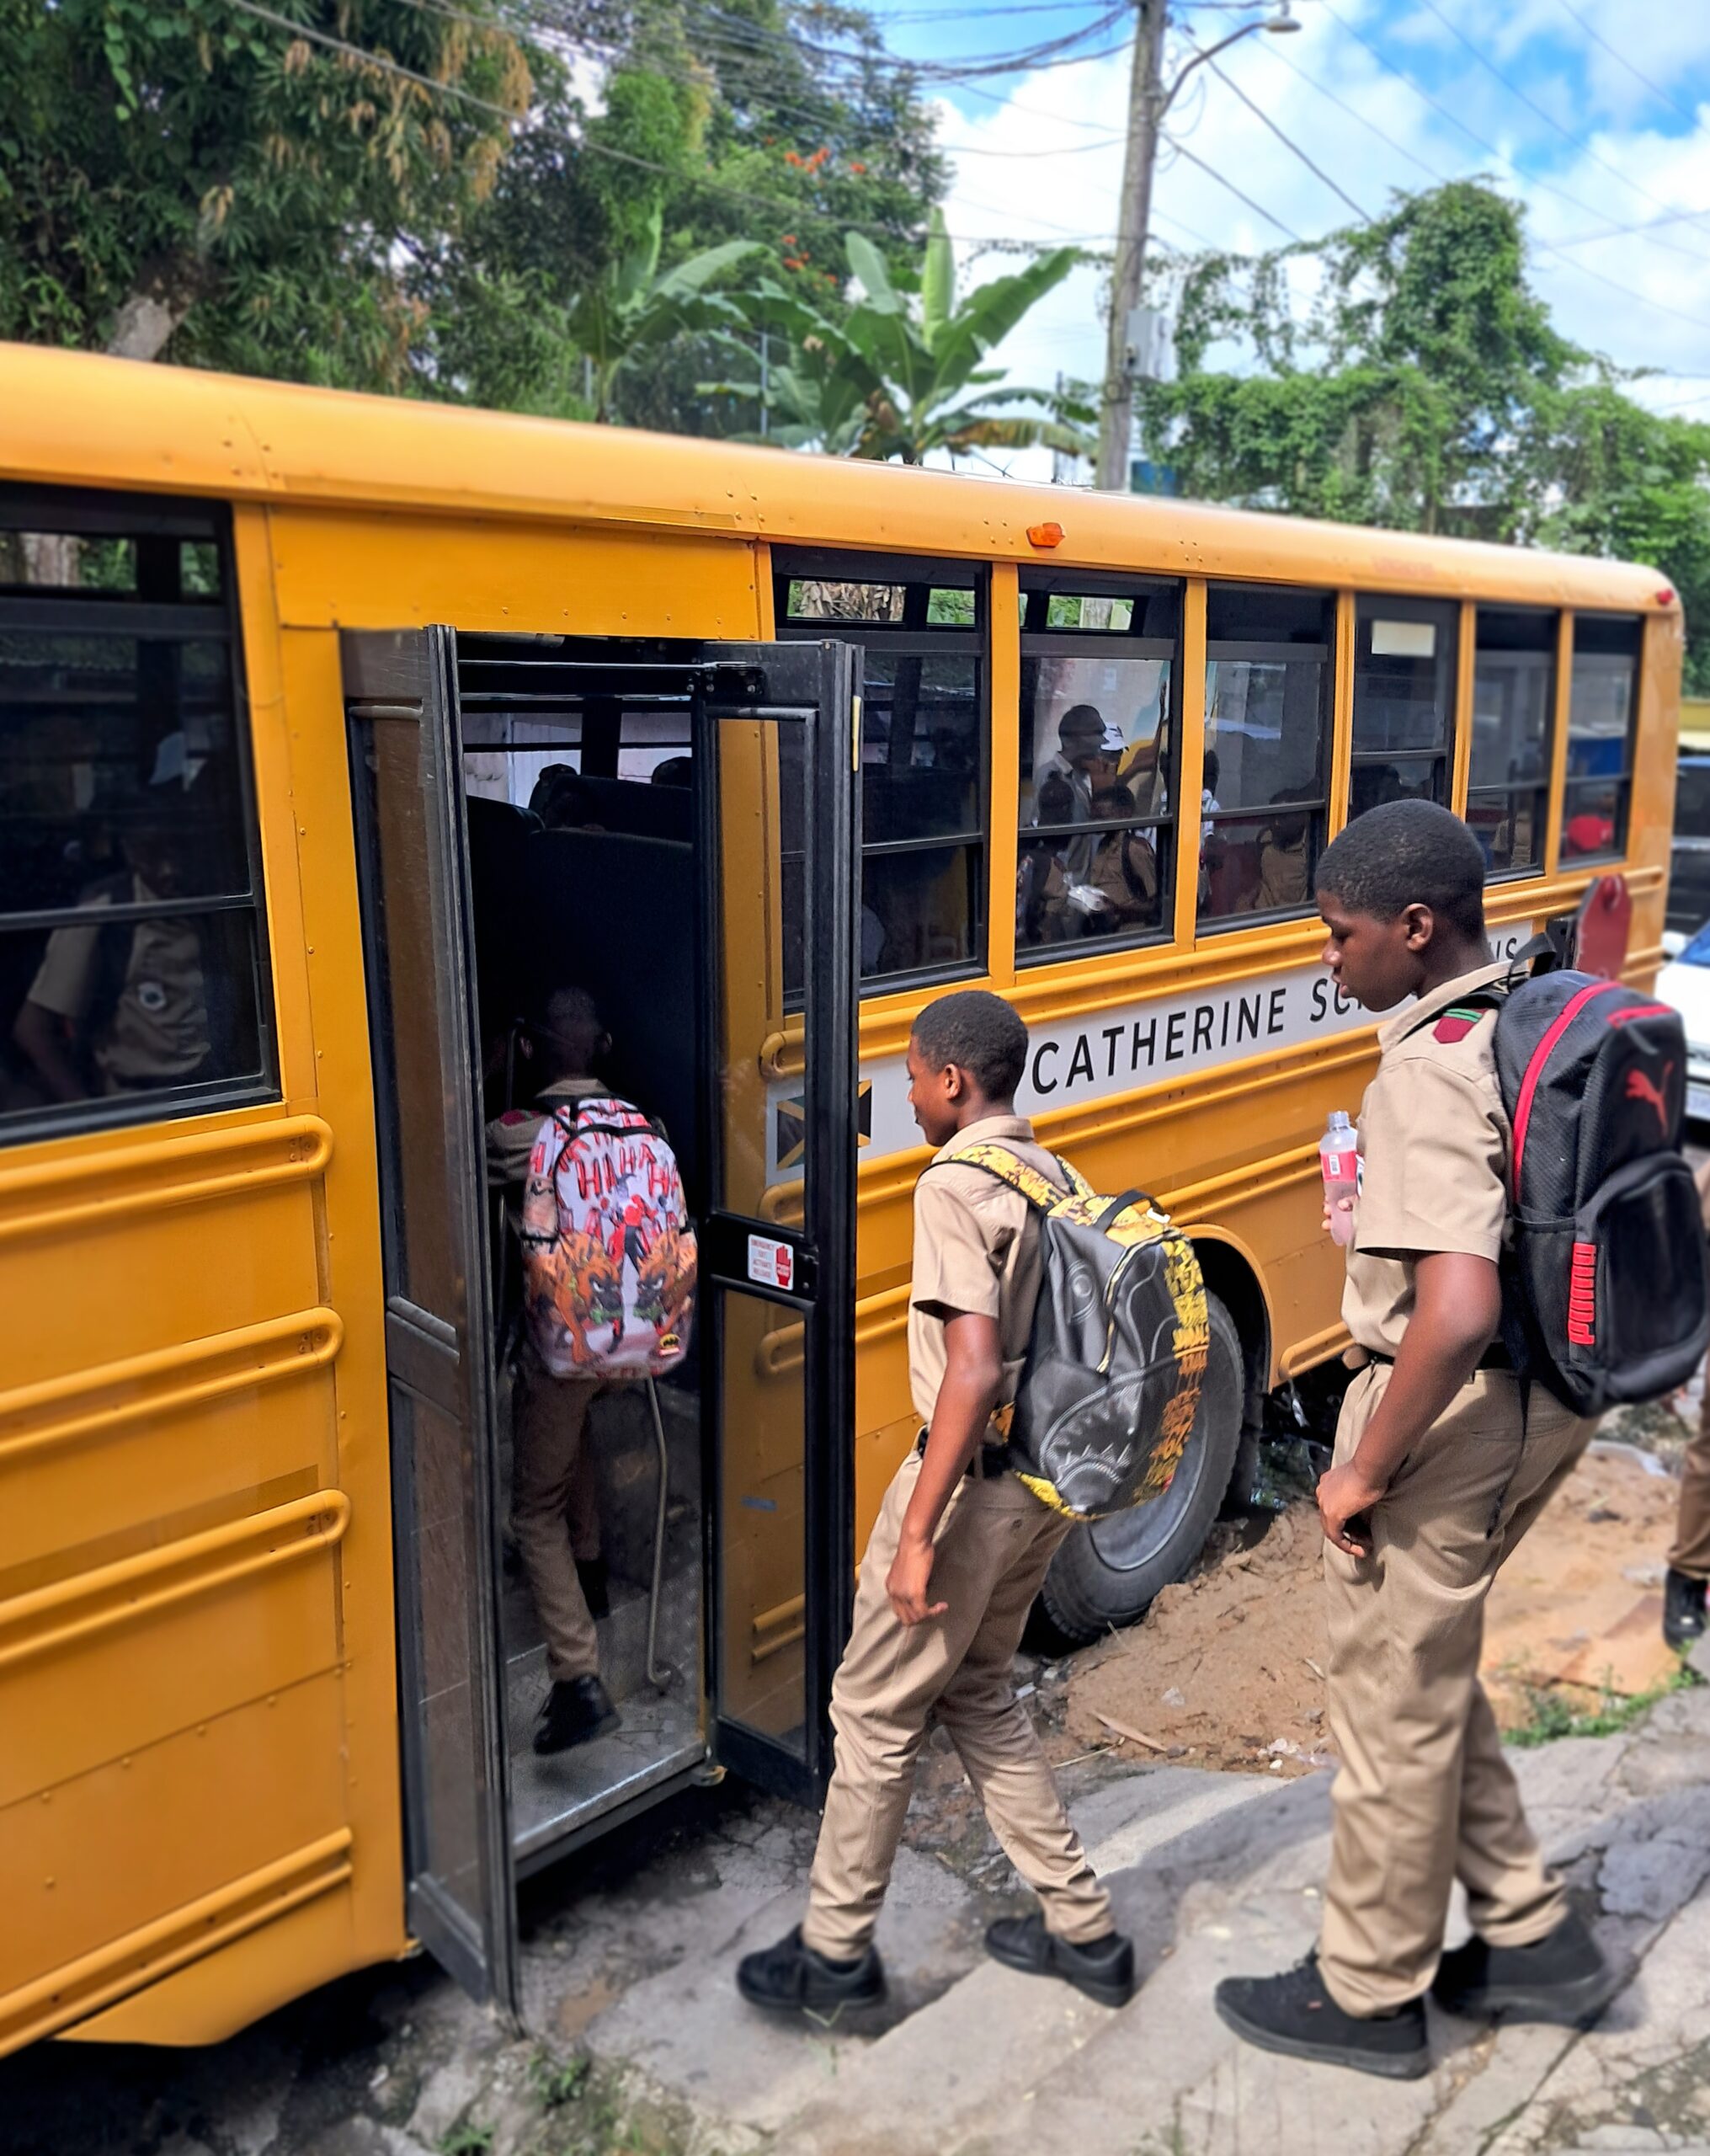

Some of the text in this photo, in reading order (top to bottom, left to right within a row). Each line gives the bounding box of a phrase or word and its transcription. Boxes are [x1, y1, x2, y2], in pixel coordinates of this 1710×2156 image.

[1032, 988, 1286, 1095] CATHERINE
[1309, 978, 1362, 1022] SC
[1568, 1242, 1596, 1345] PUMA
